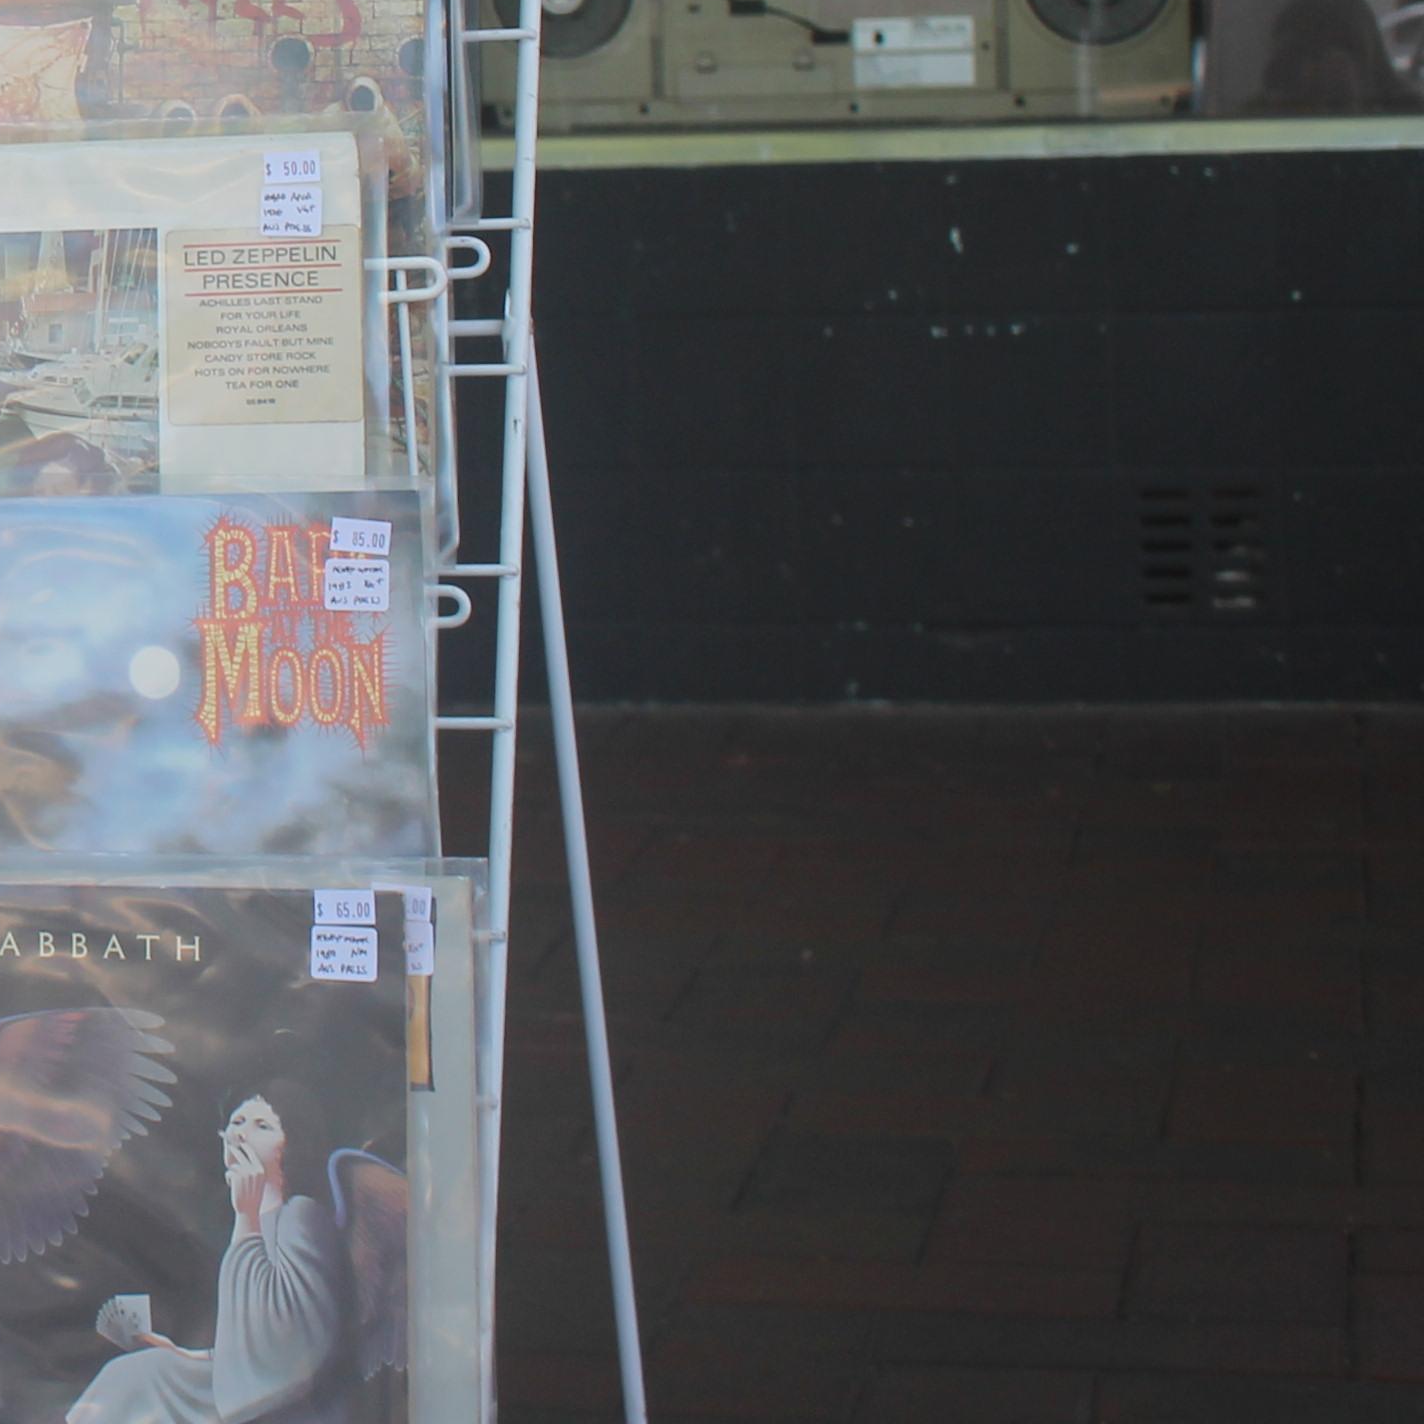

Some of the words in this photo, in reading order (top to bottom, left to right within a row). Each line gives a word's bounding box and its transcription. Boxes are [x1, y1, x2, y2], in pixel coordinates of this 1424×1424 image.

[266, 163, 272, 176] $
[283, 160, 316, 176] 50.00
[184, 249, 225, 266] LED
[233, 246, 336, 264] ZEPPELIN
[203, 271, 319, 289] PRESENCE
[199, 297, 251, 308] ACHILLES
[253, 297, 282, 306] LAST
[284, 295, 322, 305] STAND
[220, 312, 242, 320] FOR
[245, 311, 277, 320] YOUR
[280, 310, 301, 319] LIFE
[216, 325, 252, 334] ROYAL
[256, 324, 308, 333] ORLEANS
[187, 340, 242, 350] NOBODYS
[244, 339, 279, 349] FAULT
[282, 338, 303, 347] BUT
[306, 337, 334, 346] MINE
[204, 354, 243, 363] CANDY
[247, 352, 283, 362] STORE
[286, 351, 316, 360] ROCK
[194, 368, 225, 377] HOTS
[228, 367, 245, 376] ON
[248, 367, 270, 376] FOR
[272, 365, 330, 375] NOWHERE
[225, 381, 247, 390] TEA
[250, 381, 272, 389] FOR
[275, 380, 299, 389] ONE
[333, 530, 339, 543] $
[352, 531, 386, 549] 85.00
[196, 616, 390, 746] MOON
[317, 902, 323, 917] $
[336, 901, 371, 918] 65.00
